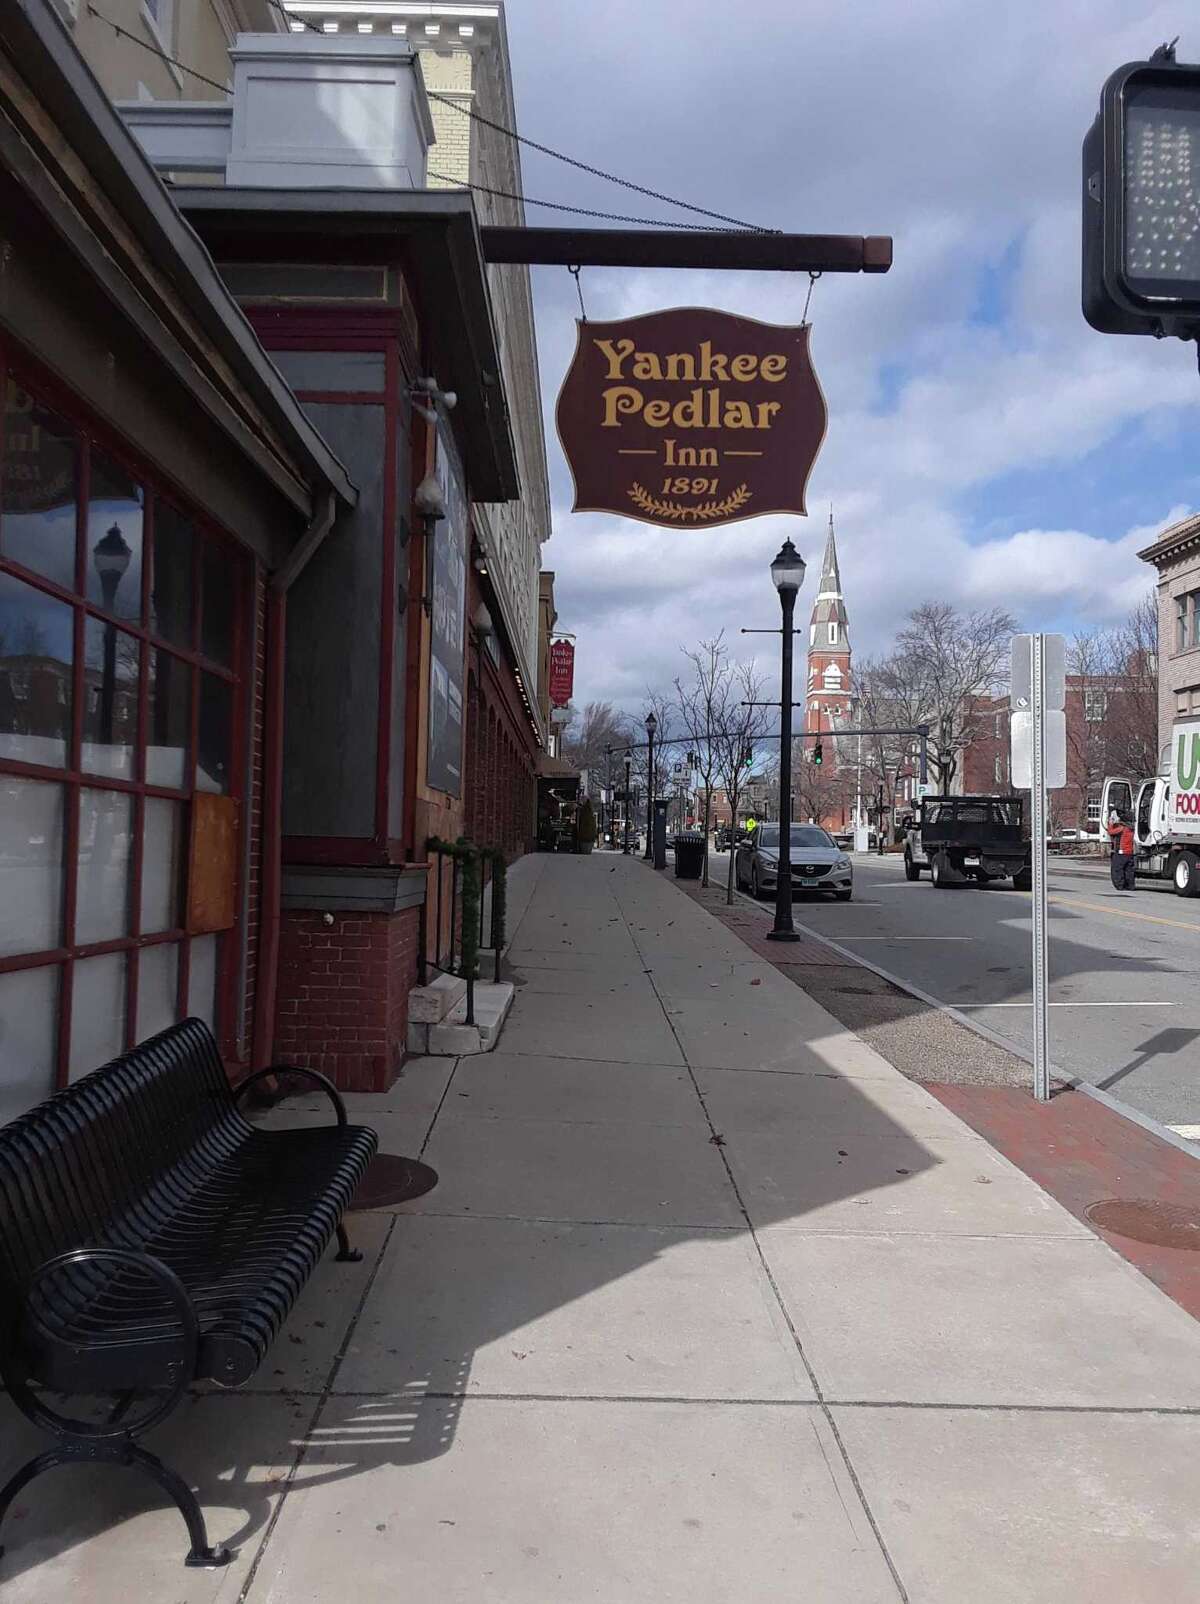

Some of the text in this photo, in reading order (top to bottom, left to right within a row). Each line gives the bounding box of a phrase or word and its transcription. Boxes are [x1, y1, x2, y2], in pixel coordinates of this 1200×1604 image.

[593, 338, 788, 382] Yankee
[601, 386, 781, 429] Pedlar
[663, 439, 719, 466] Inn
[661, 477, 720, 495] 1891
